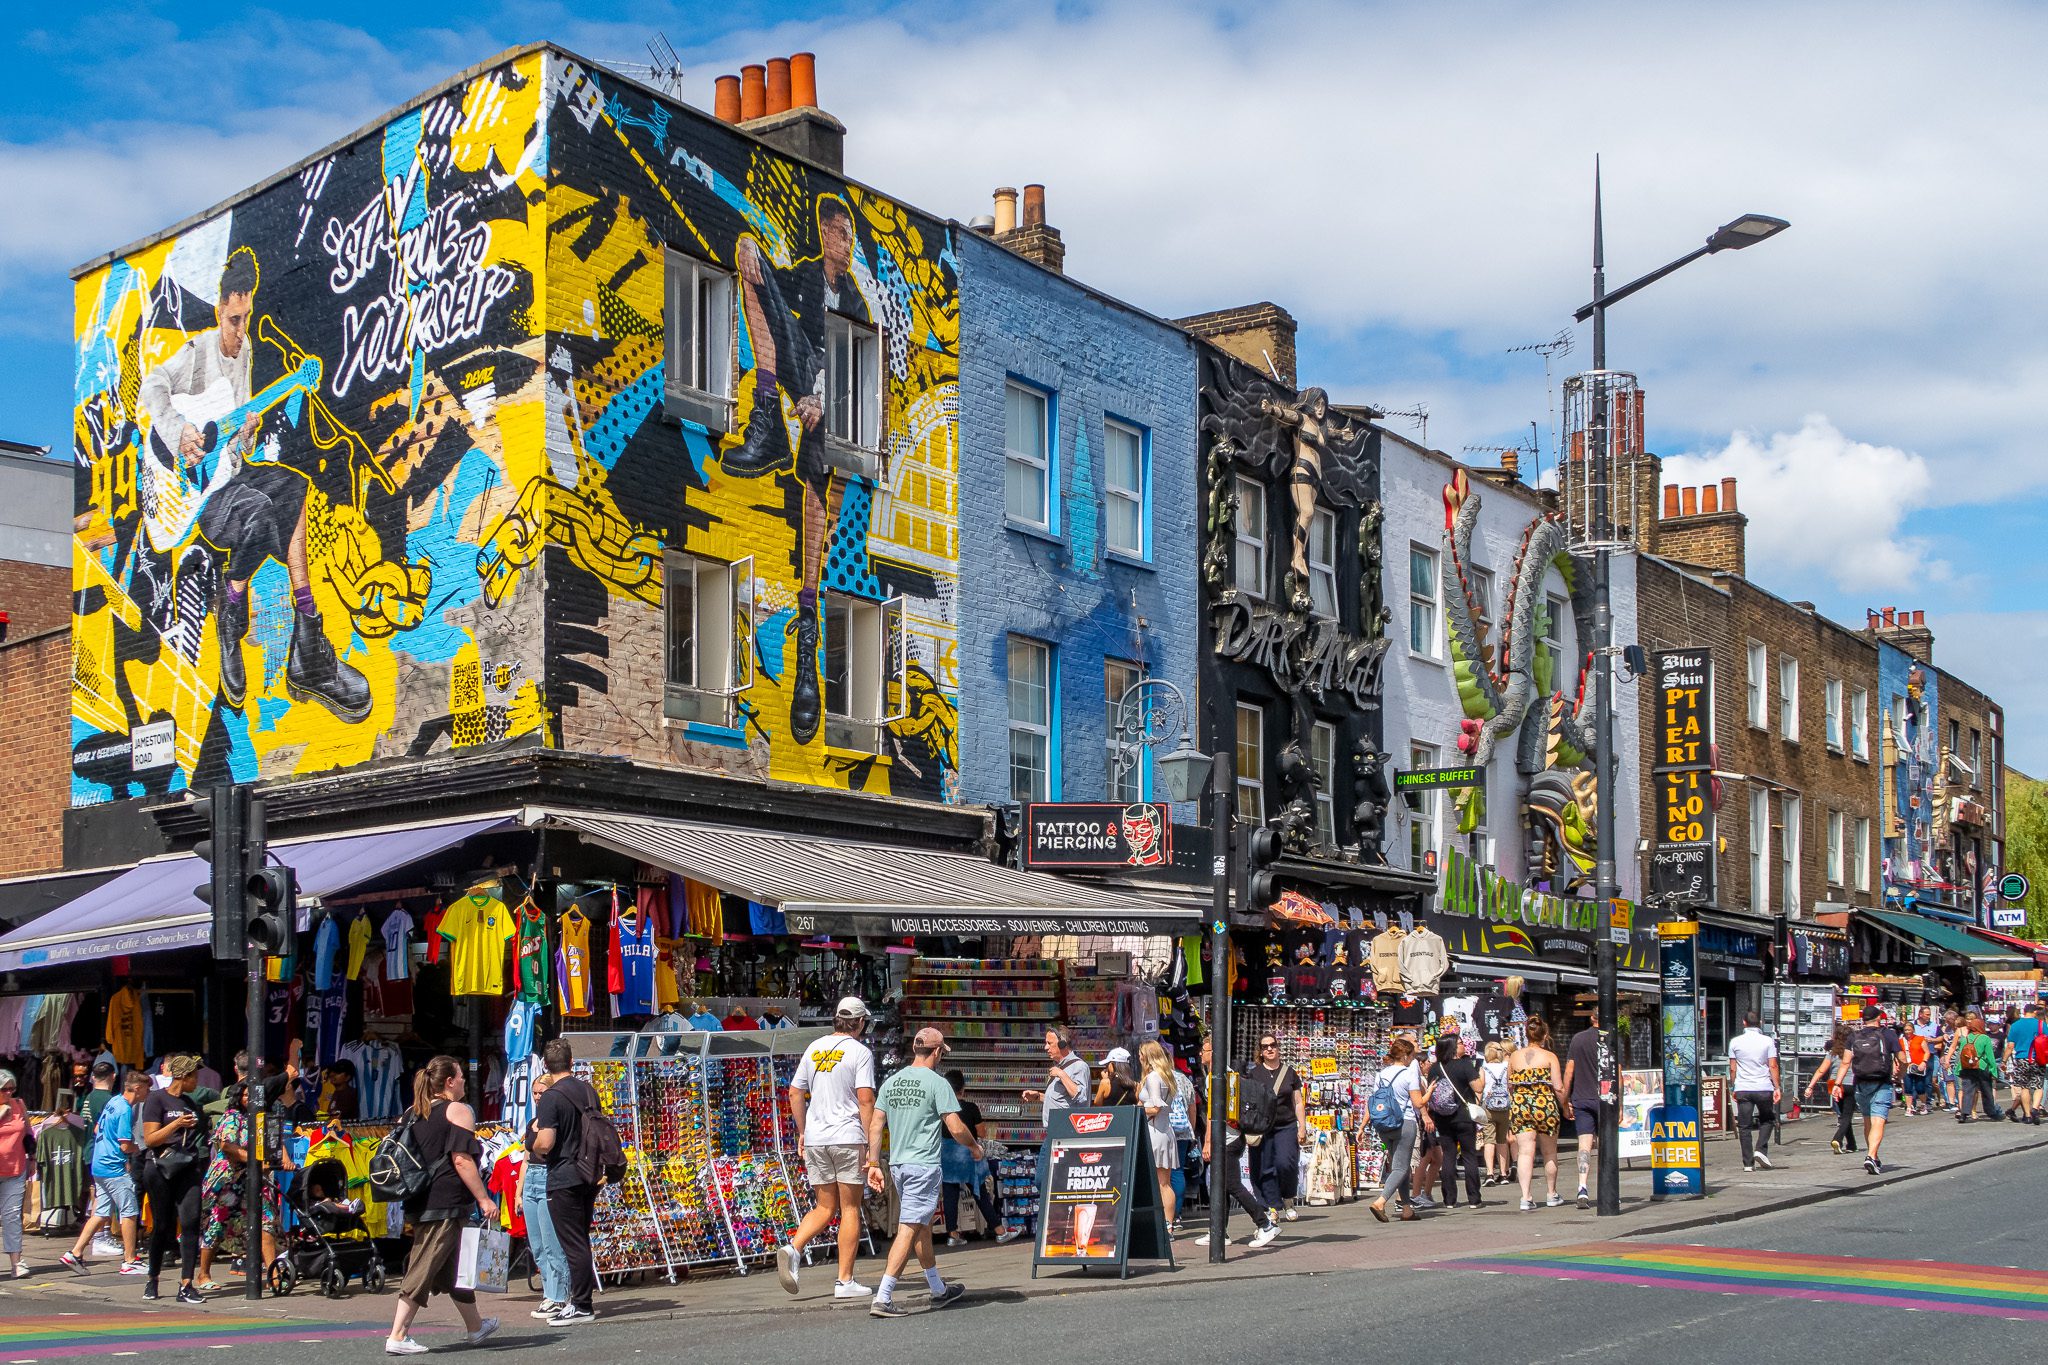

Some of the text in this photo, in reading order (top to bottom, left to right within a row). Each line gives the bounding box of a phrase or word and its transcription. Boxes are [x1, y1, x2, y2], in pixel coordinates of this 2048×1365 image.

[1662, 655, 1702, 670] Blue
[484, 661, 521, 686] Martens
[1662, 672, 1704, 689] Skin
[134, 732, 172, 749] JAMESTOWN
[134, 752, 153, 765] ROAD
[1397, 770, 1476, 785] CHINESE BUFFET
[1037, 822, 1118, 836] TATTOO &
[1037, 836, 1117, 850] PIERCING
[1676, 863, 1685, 874] &
[1436, 845, 1476, 917] ALL
[1475, 864, 1523, 923] YOU
[1521, 888, 1564, 928] CAN
[1563, 898, 1598, 932] EAT
[797, 916, 815, 930] 267
[1997, 913, 2021, 922] ATM
[932, 919, 1001, 932] ACCESSORIES
[1010, 920, 1060, 932] SOUVENIRS
[1066, 920, 1107, 933] CHILDREN
[1107, 921, 1149, 933] CLOTHING
[77, 947, 87, 955] Ice
[89, 944, 110, 954] Cream
[116, 939, 139, 950] Coffee
[147, 932, 189, 946] Sandwiches
[1544, 939, 1588, 953] CAMDEN MARKET
[631, 961, 636, 976] 1
[511, 1014, 523, 1037] 9
[811, 1050, 845, 1062] GAME
[893, 1076, 921, 1088] deus
[888, 1097, 921, 1109] cycles
[1077, 1113, 1108, 1128] Camden
[1652, 1121, 1697, 1138] ATM
[1654, 1147, 1697, 1163] HERE
[1068, 1166, 1111, 1178] FREAKY
[1067, 1177, 1110, 1190] FRIDAY
